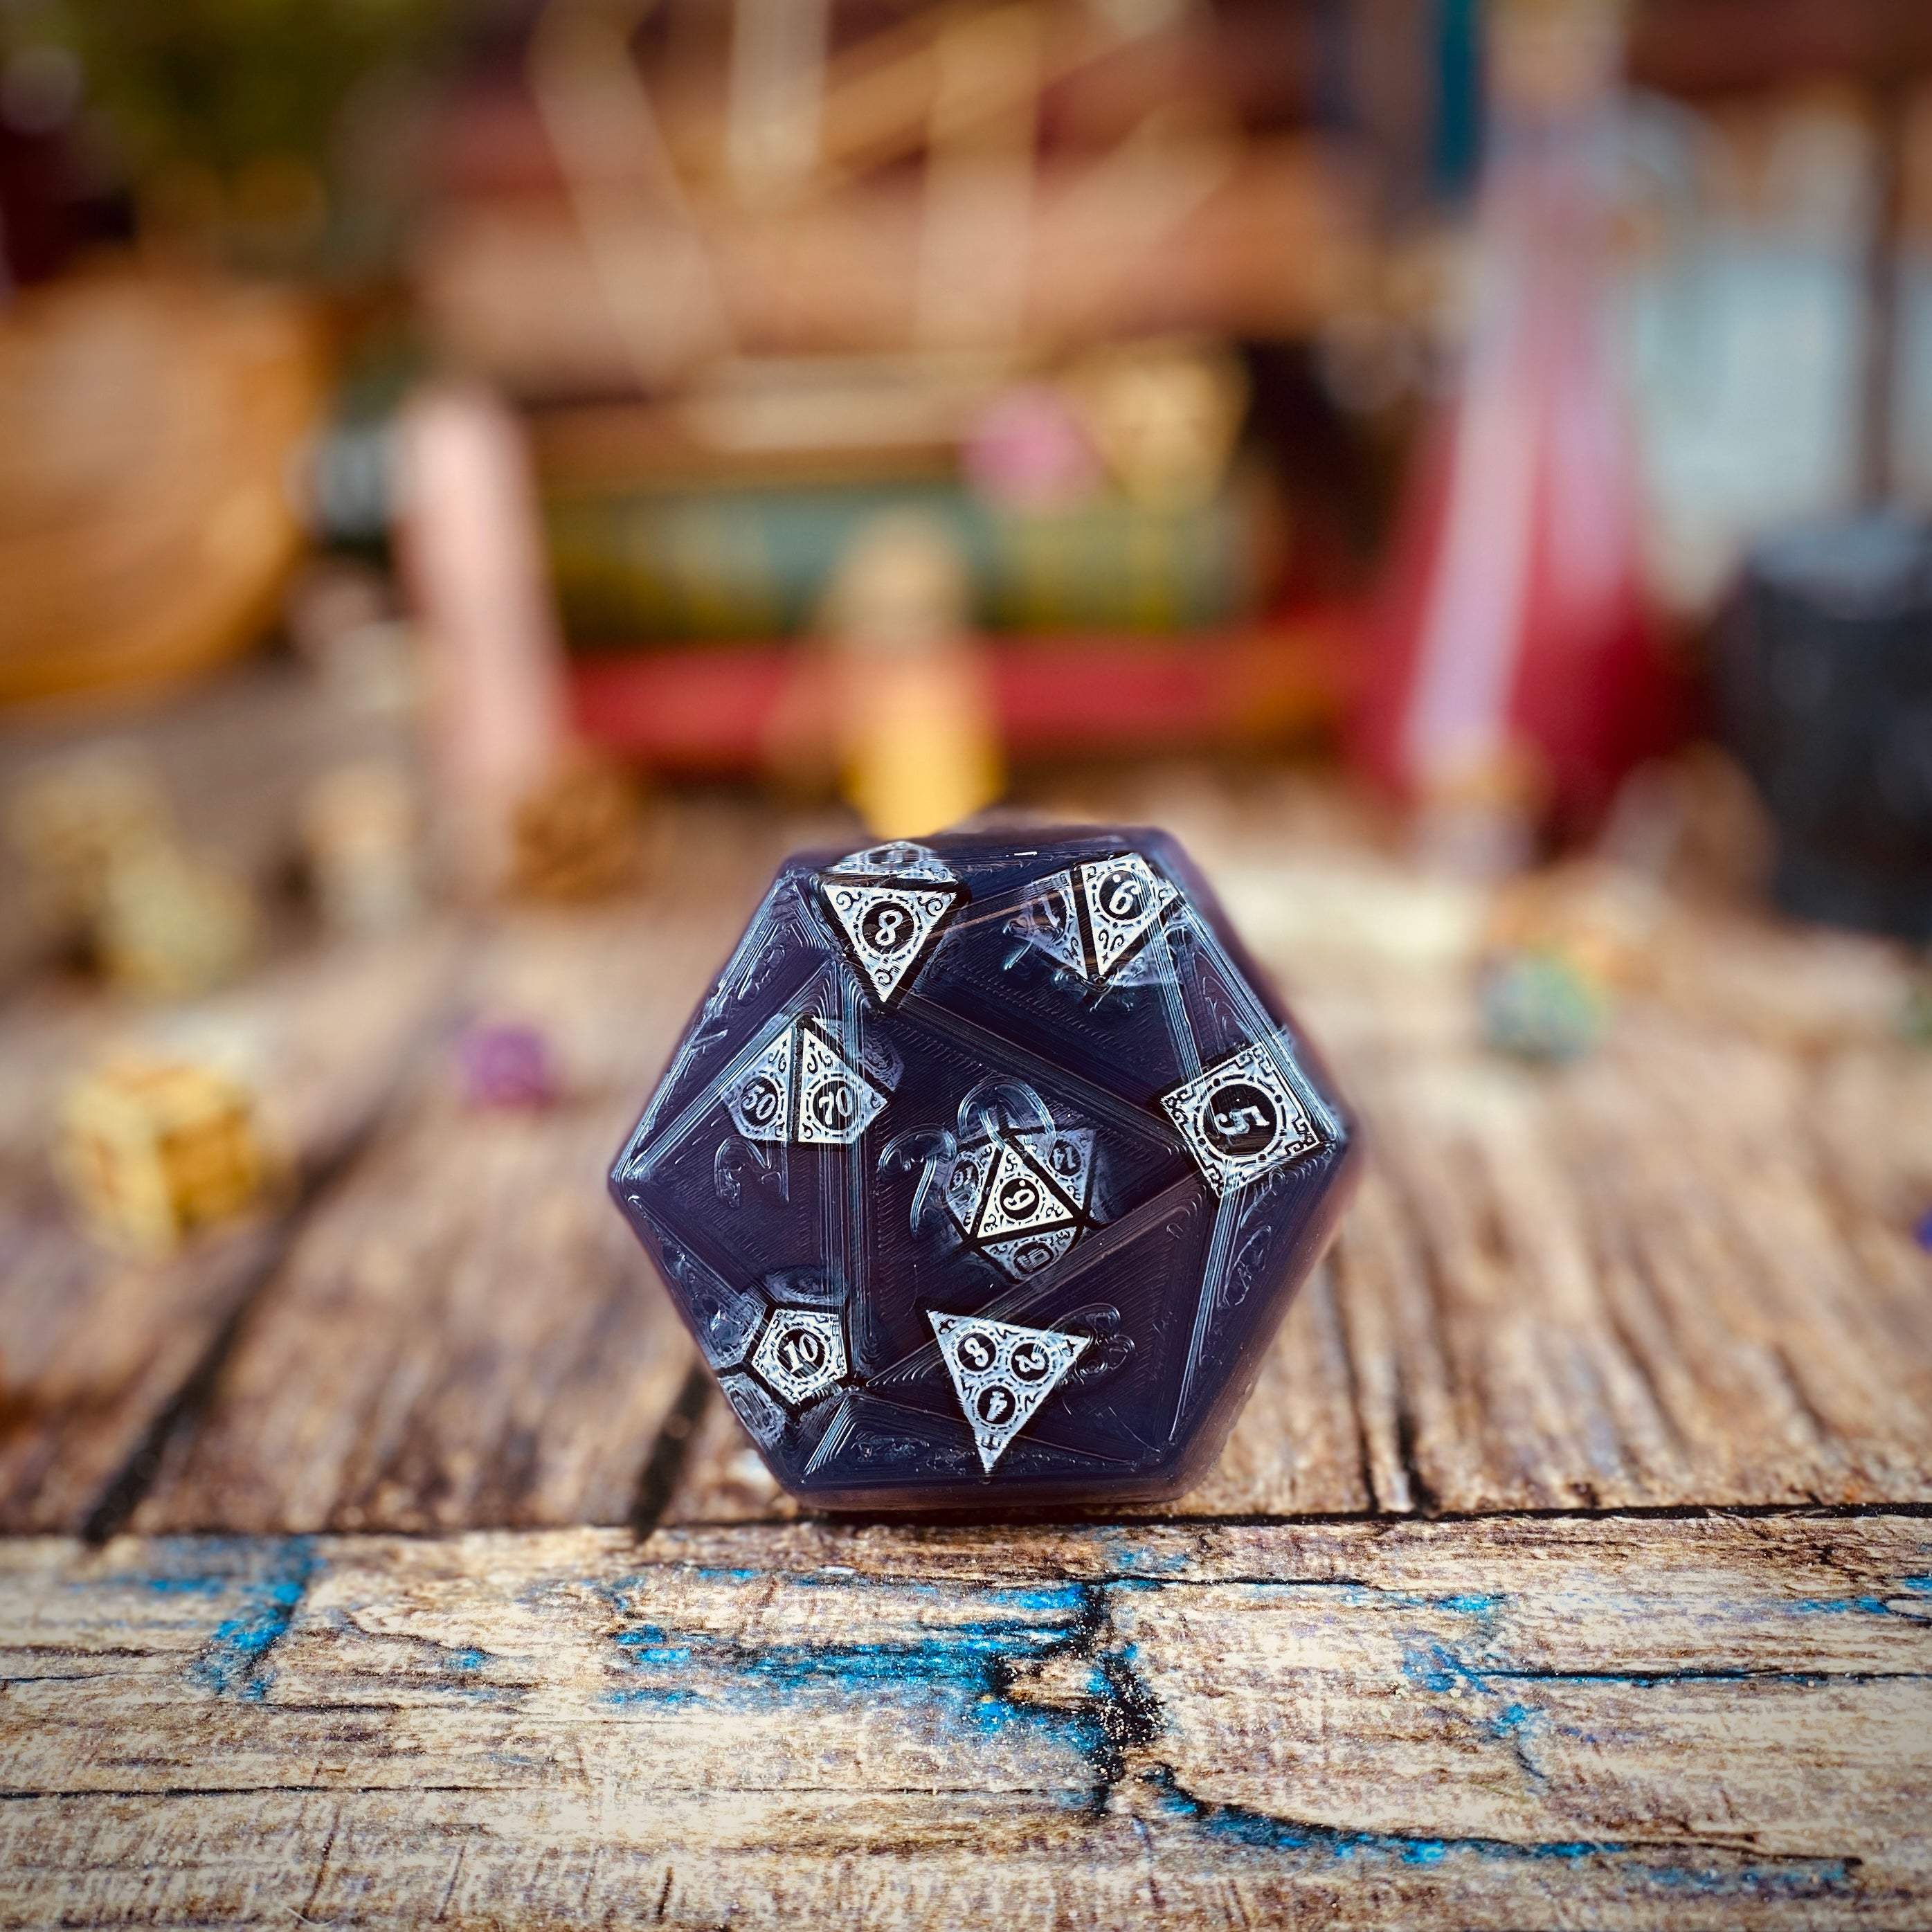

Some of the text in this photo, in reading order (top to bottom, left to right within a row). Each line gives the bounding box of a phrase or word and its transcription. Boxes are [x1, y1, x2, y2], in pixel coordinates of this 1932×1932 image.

[875, 910, 903, 946] 8
[742, 1084, 777, 1120] 50
[818, 1086, 853, 1125] 70
[1216, 1105, 1270, 1136] 5
[783, 1333, 818, 1374] 10
